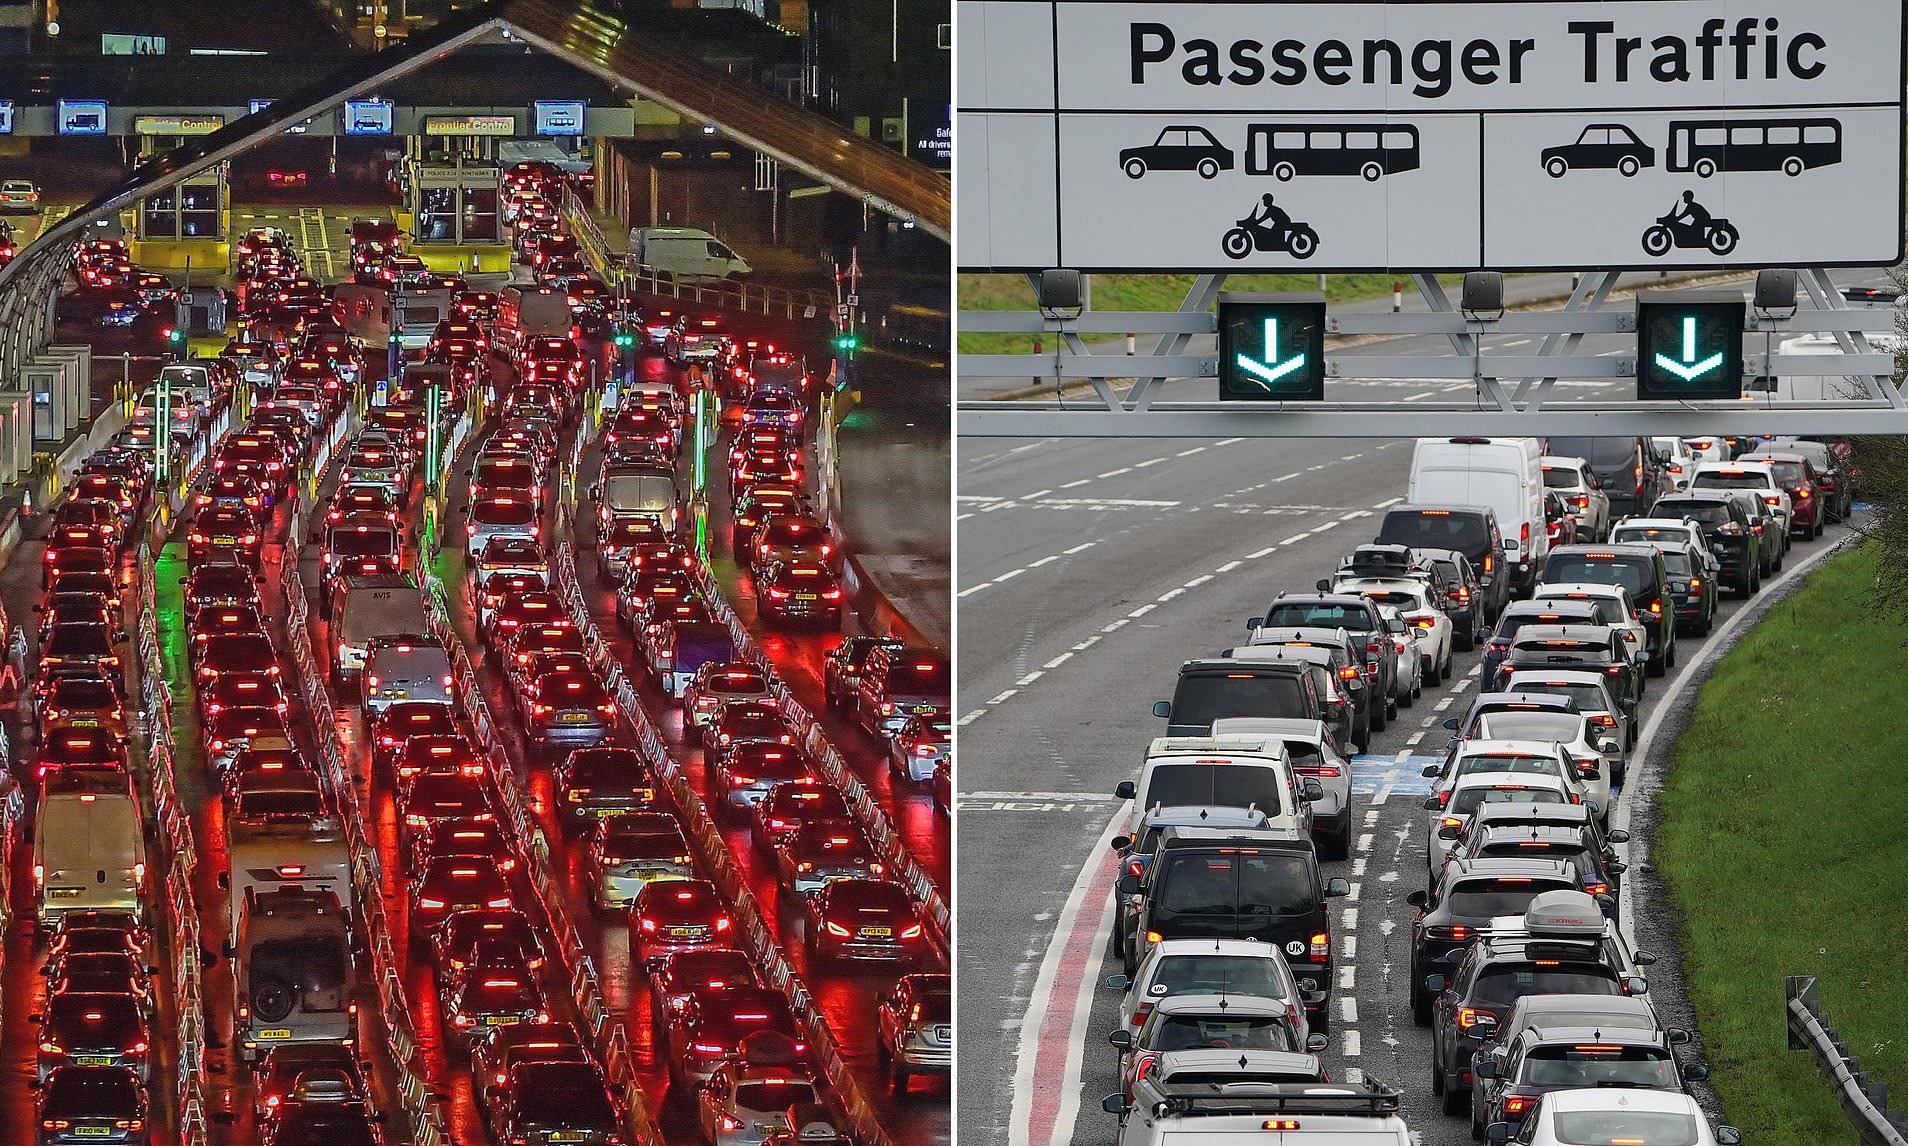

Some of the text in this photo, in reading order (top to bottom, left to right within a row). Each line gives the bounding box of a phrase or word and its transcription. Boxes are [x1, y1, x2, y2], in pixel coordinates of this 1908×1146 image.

[1130, 17, 1827, 98] Passenger Traffic
[429, 121, 511, 130] Frontier Control
[918, 140, 927, 149] All
[1288, 943, 1303, 952] UK
